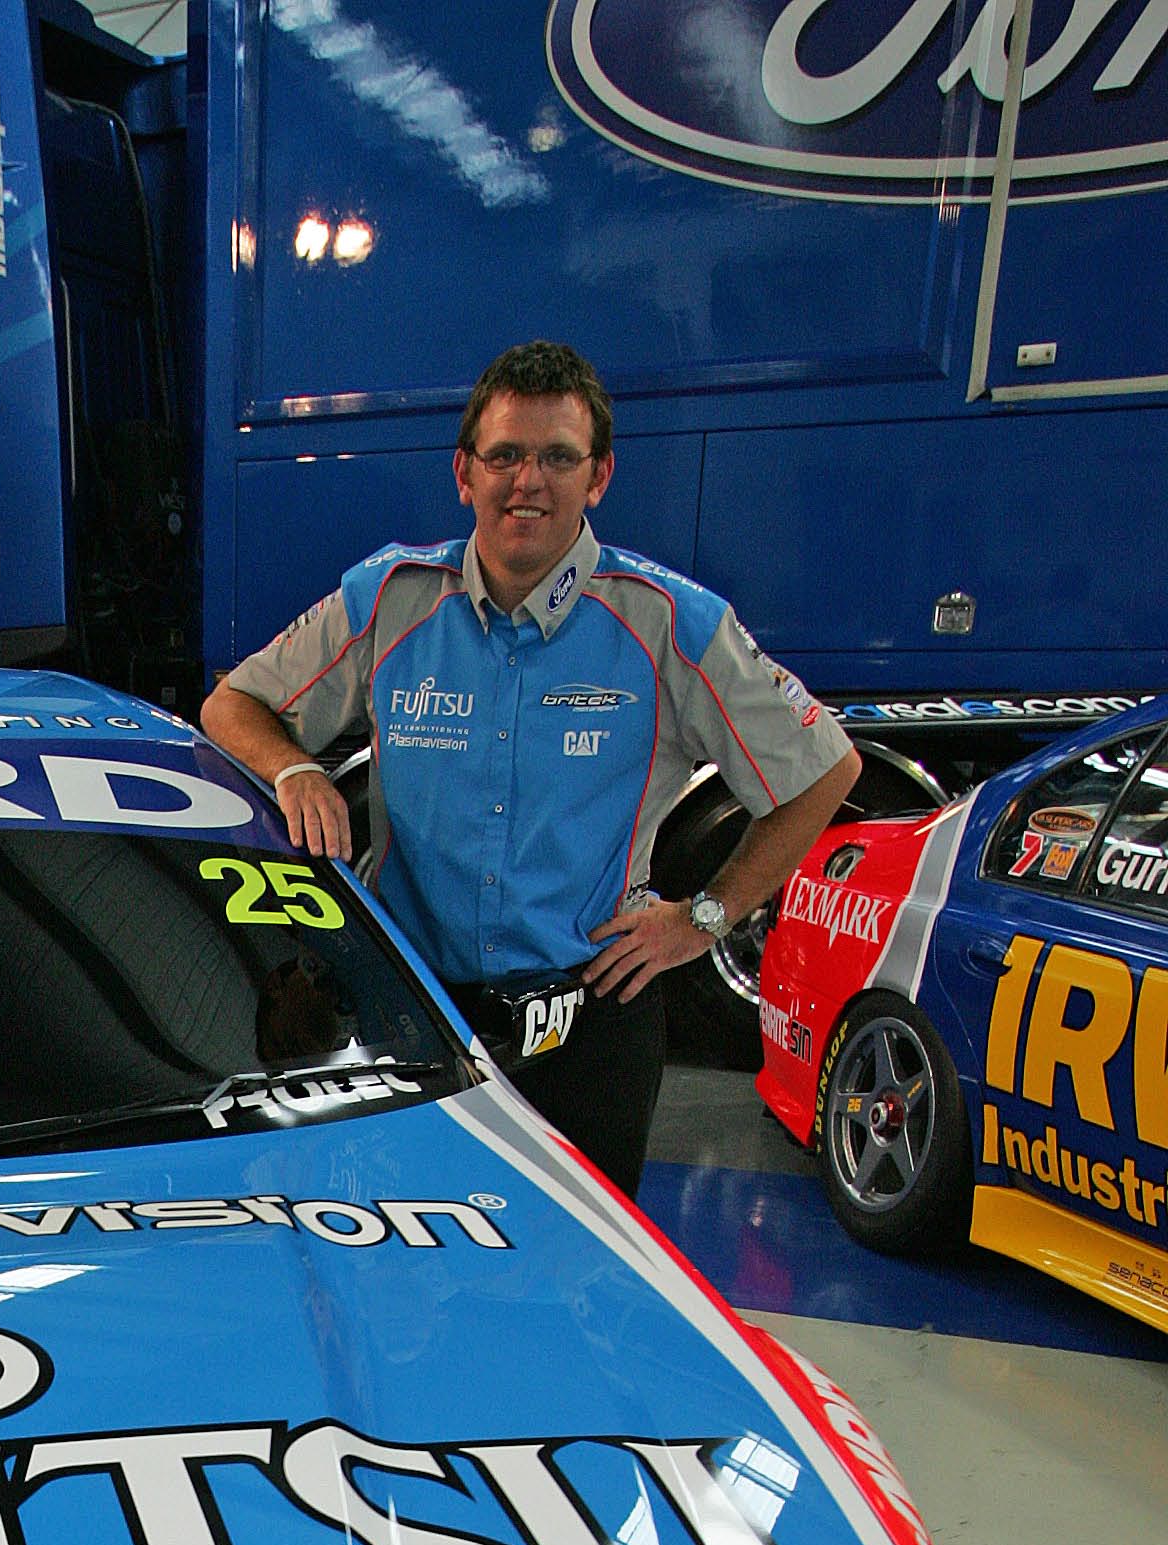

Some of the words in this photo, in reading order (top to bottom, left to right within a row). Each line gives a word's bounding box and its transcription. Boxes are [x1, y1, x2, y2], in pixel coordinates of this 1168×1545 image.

[552, 571, 574, 604] Ford
[390, 676, 474, 722] FUJITSU
[387, 732, 468, 752] Plasmavision
[199, 857, 345, 930] 25
[782, 868, 892, 950] LEXMARK
[815, 1021, 849, 1135] DUNLOP
